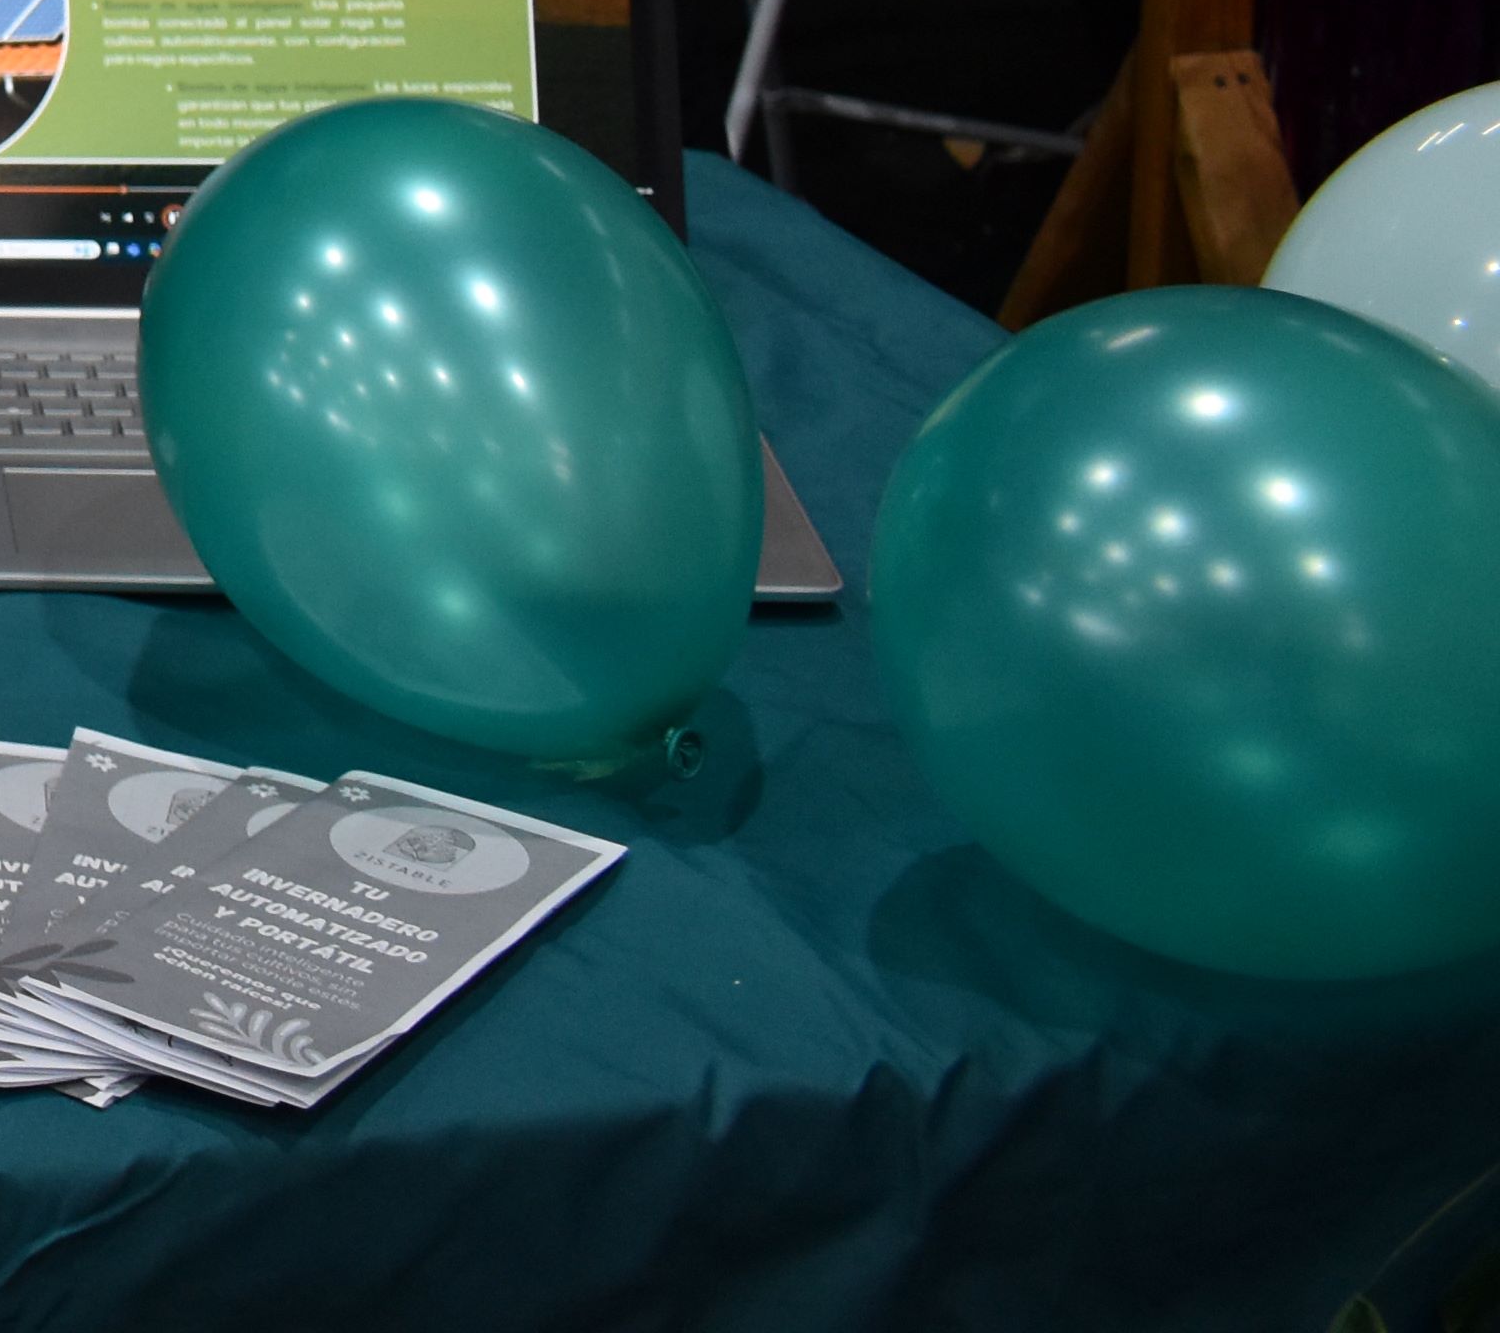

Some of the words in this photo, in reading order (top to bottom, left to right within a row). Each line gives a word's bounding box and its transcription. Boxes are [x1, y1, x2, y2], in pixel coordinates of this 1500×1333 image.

[354, 852, 450, 889] ZISTABLE
[242, 868, 439, 943] INVERNADERO
[350, 881, 390, 901] TU
[208, 883, 428, 963] AUTOMATIZADO
[214, 905, 236, 918] Y
[239, 917, 376, 974] PORTÁTIL
[154, 953, 216, 981] echen
[281, 992, 322, 1010] que
